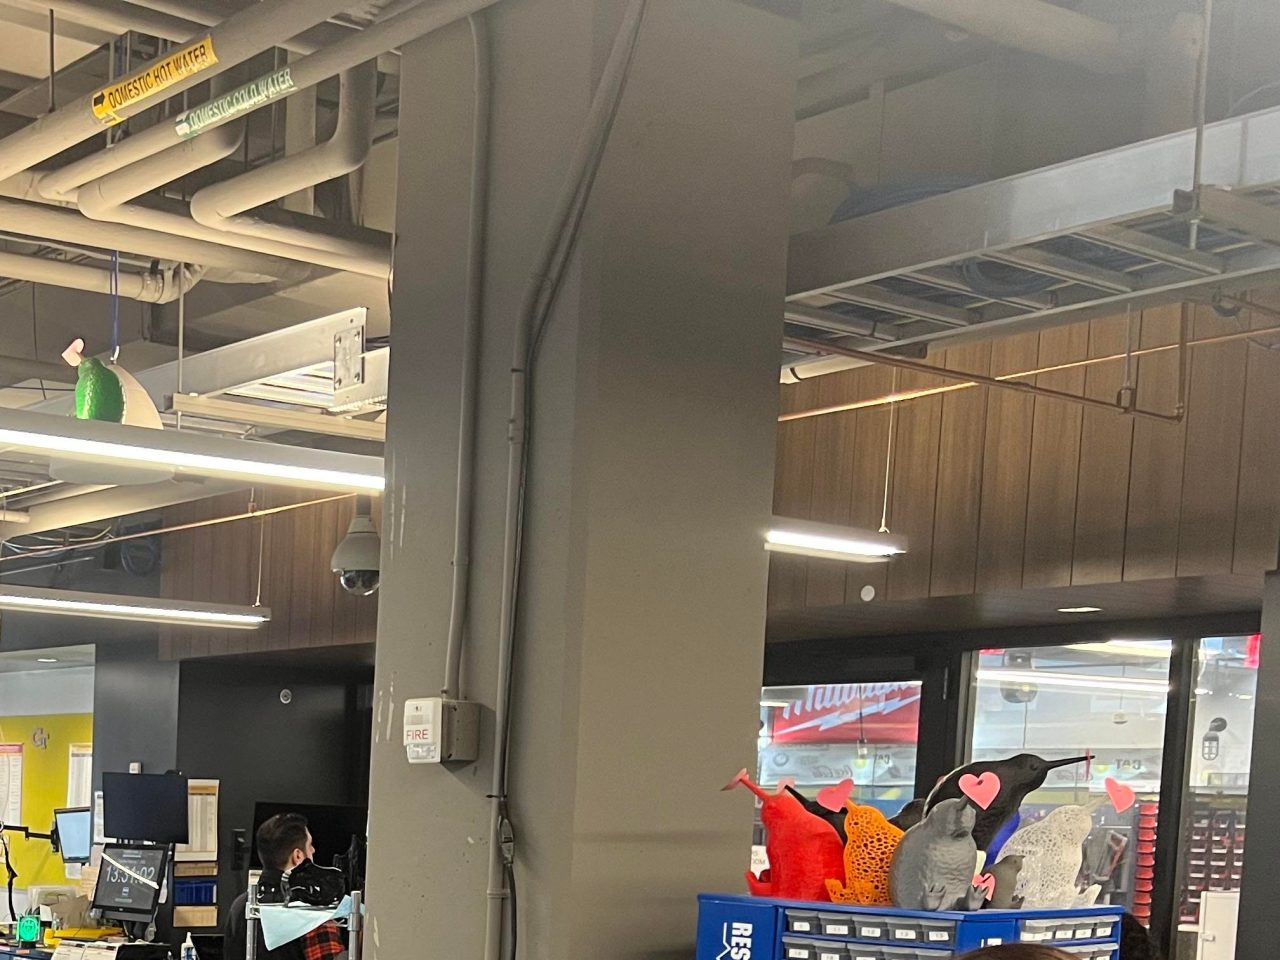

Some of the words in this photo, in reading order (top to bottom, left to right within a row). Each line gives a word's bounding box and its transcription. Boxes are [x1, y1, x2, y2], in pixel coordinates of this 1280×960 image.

[108, 72, 154, 109] DOMESTIC
[154, 62, 172, 87] HOT
[173, 44, 207, 74] WATER
[188, 98, 234, 130] DOMESTIC
[258, 67, 294, 101] WATER
[406, 728, 429, 741] FIRE
